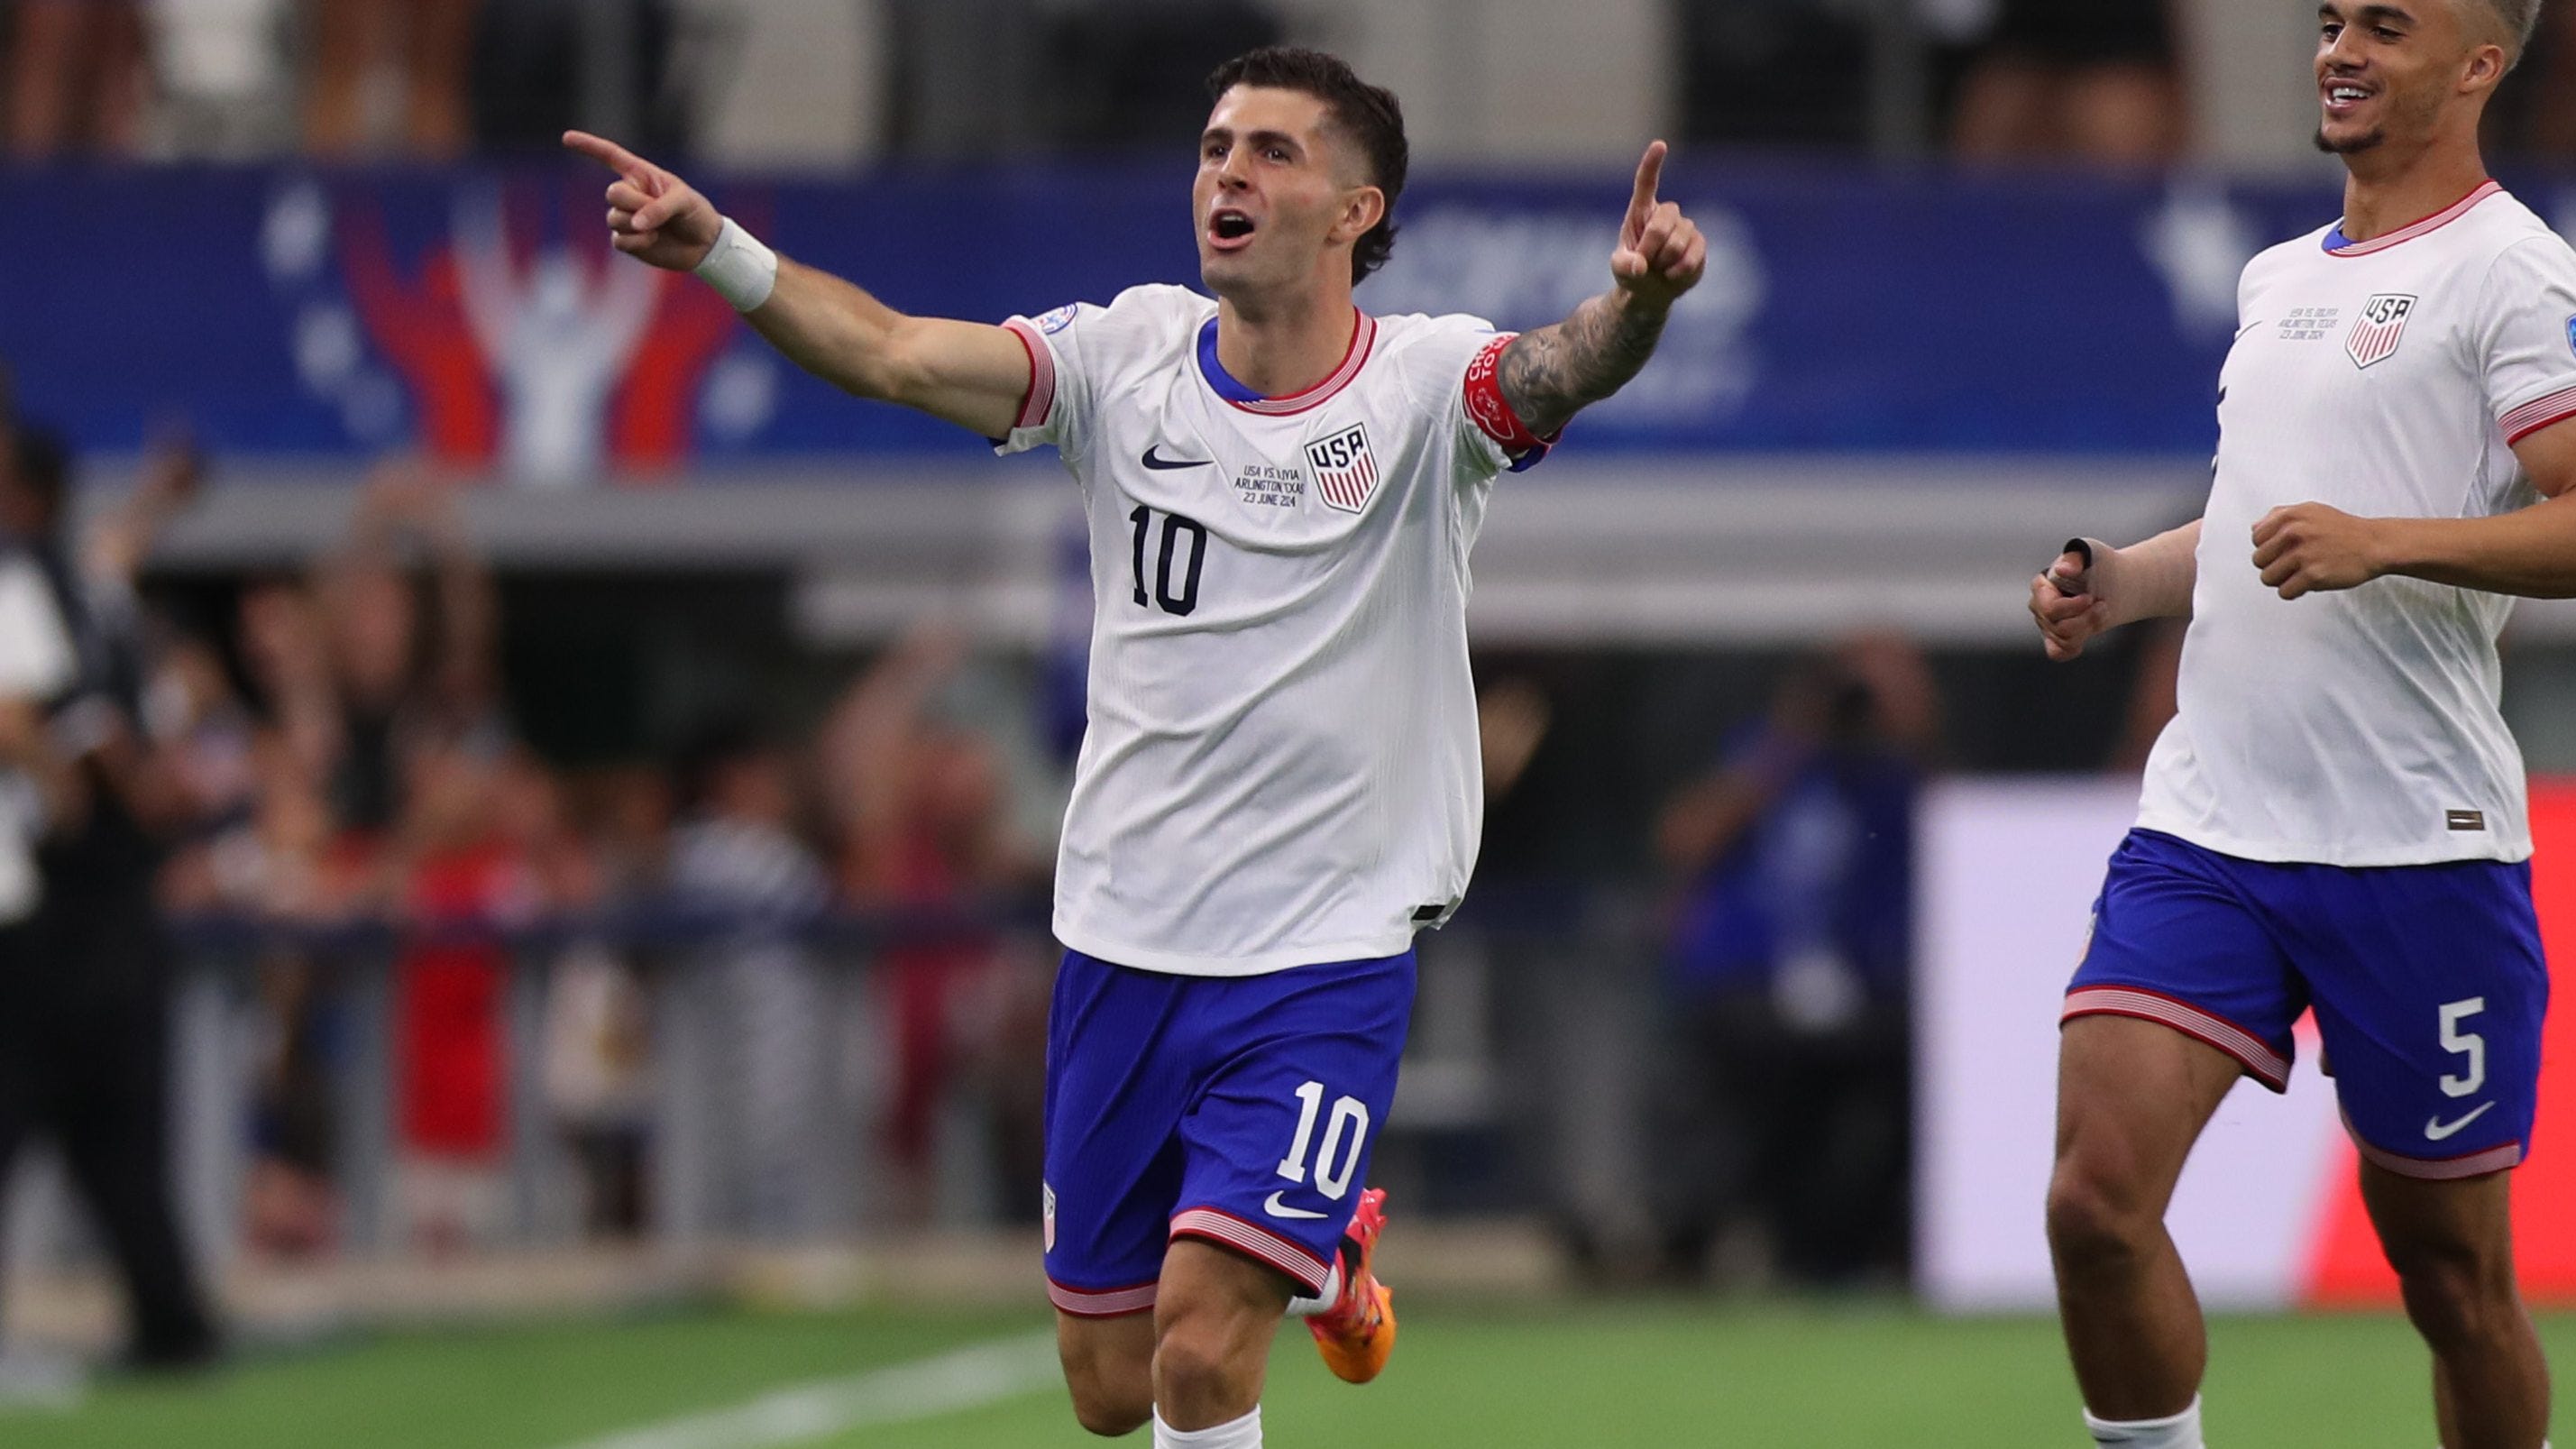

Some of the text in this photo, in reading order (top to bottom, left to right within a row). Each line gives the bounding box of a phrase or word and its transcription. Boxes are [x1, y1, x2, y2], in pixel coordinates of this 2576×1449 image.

[2365, 298, 2411, 325] USA
[1469, 343, 1494, 381] CHO
[1481, 353, 1495, 381] TO
[1311, 429, 1364, 469] USA
[1243, 464, 1260, 477] USA
[1243, 491, 1256, 504] 23
[1257, 493, 1279, 506] JUNE
[1129, 504, 1208, 618] 10
[2438, 996, 2485, 1098] 5
[1276, 1080, 1370, 1201] 10
